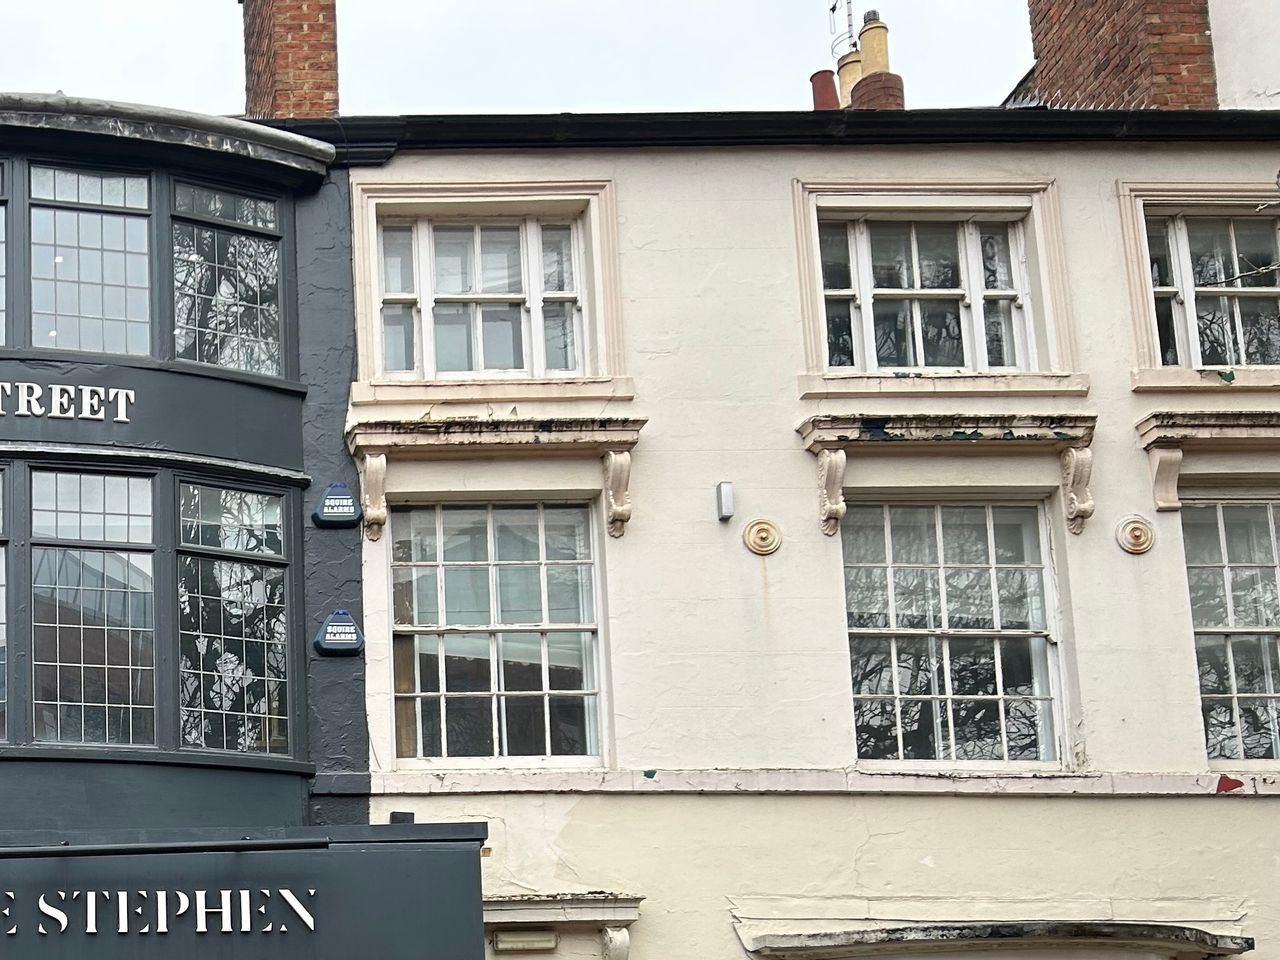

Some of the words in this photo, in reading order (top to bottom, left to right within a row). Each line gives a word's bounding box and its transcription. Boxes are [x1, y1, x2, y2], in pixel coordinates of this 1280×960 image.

[325, 498, 353, 506] SQUIRE
[323, 505, 355, 513] ALARMS
[325, 633, 357, 641] ALARMS
[36, 888, 317, 935] STEPHEN
